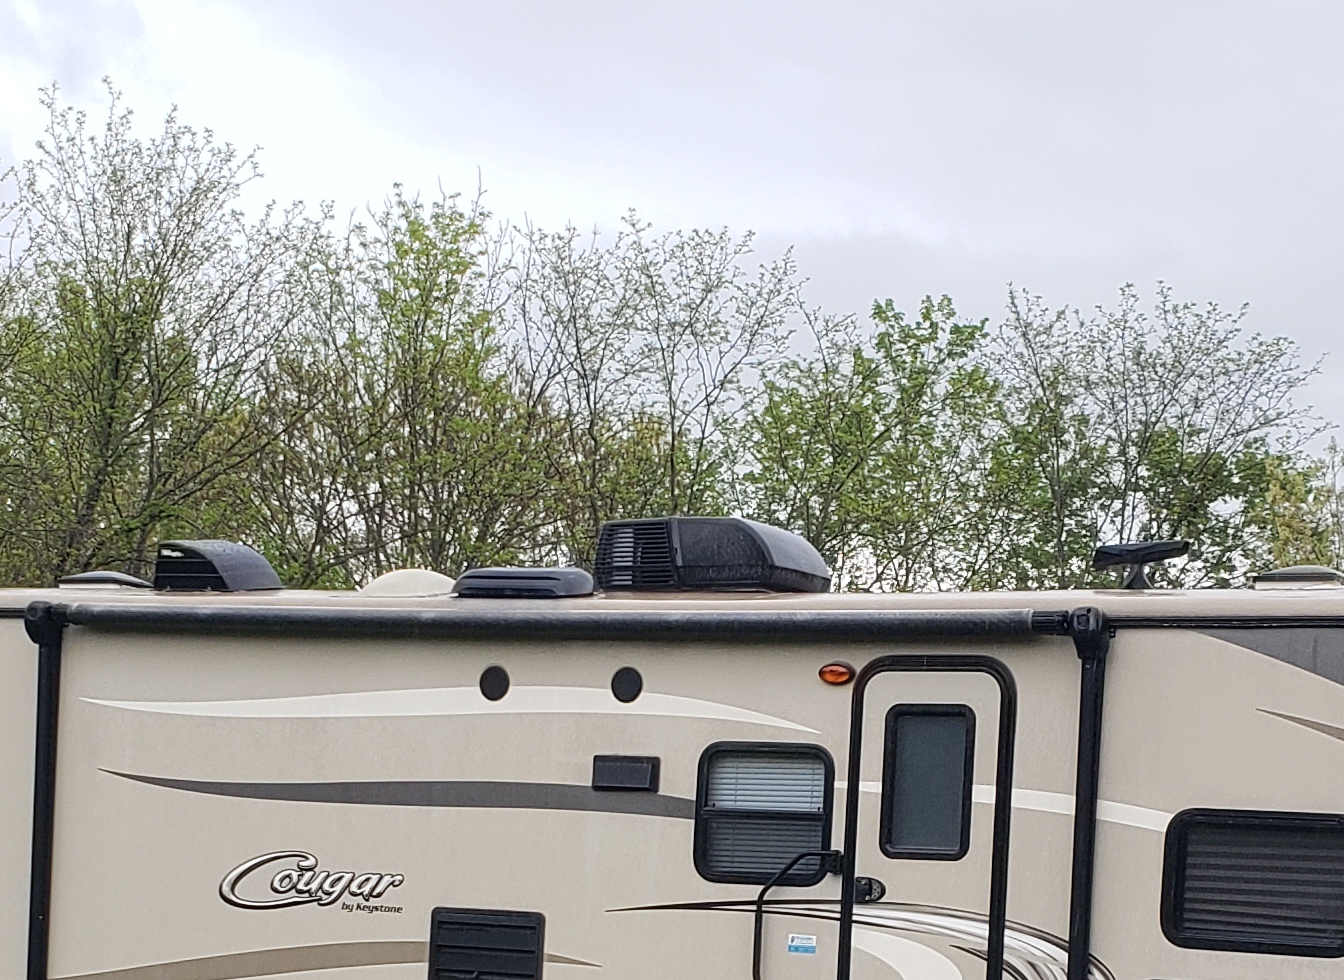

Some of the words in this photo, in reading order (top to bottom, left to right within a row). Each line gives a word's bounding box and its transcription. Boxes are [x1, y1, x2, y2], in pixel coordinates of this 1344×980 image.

[219, 850, 405, 911] Cougar
[341, 902, 354, 913] by
[356, 903, 403, 914] Keystone
